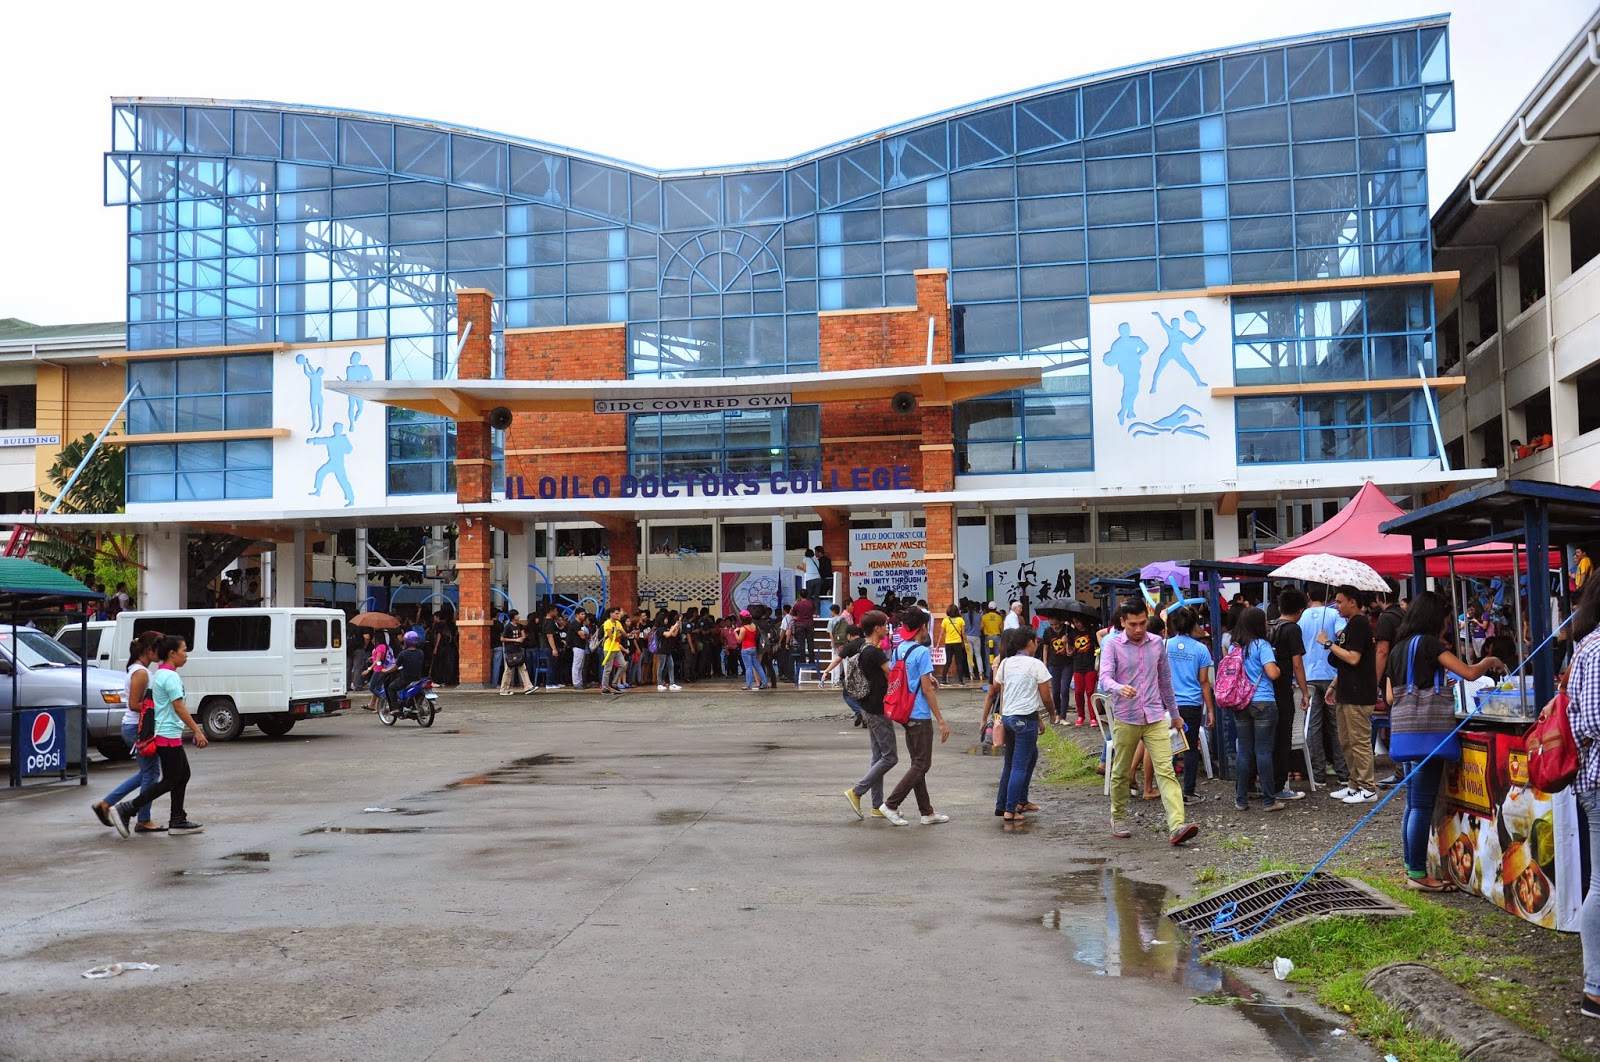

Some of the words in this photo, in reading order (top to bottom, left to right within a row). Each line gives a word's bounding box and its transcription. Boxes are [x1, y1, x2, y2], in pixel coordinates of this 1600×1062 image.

[610, 401, 644, 411] IDC
[652, 398, 740, 410] COVERED
[748, 396, 788, 407] GYM
[505, 475, 611, 500] ILOILO
[769, 465, 912, 495] COLLEGE
[861, 542, 897, 551] LITERARY
[899, 540, 927, 549] MUSIC
[891, 551, 907, 559] AND
[885, 569, 914, 577] SOARING
[893, 576, 921, 584] THROUGH
[892, 584, 917, 592] SPORTS
[27, 749, 60, 773] pepsi
